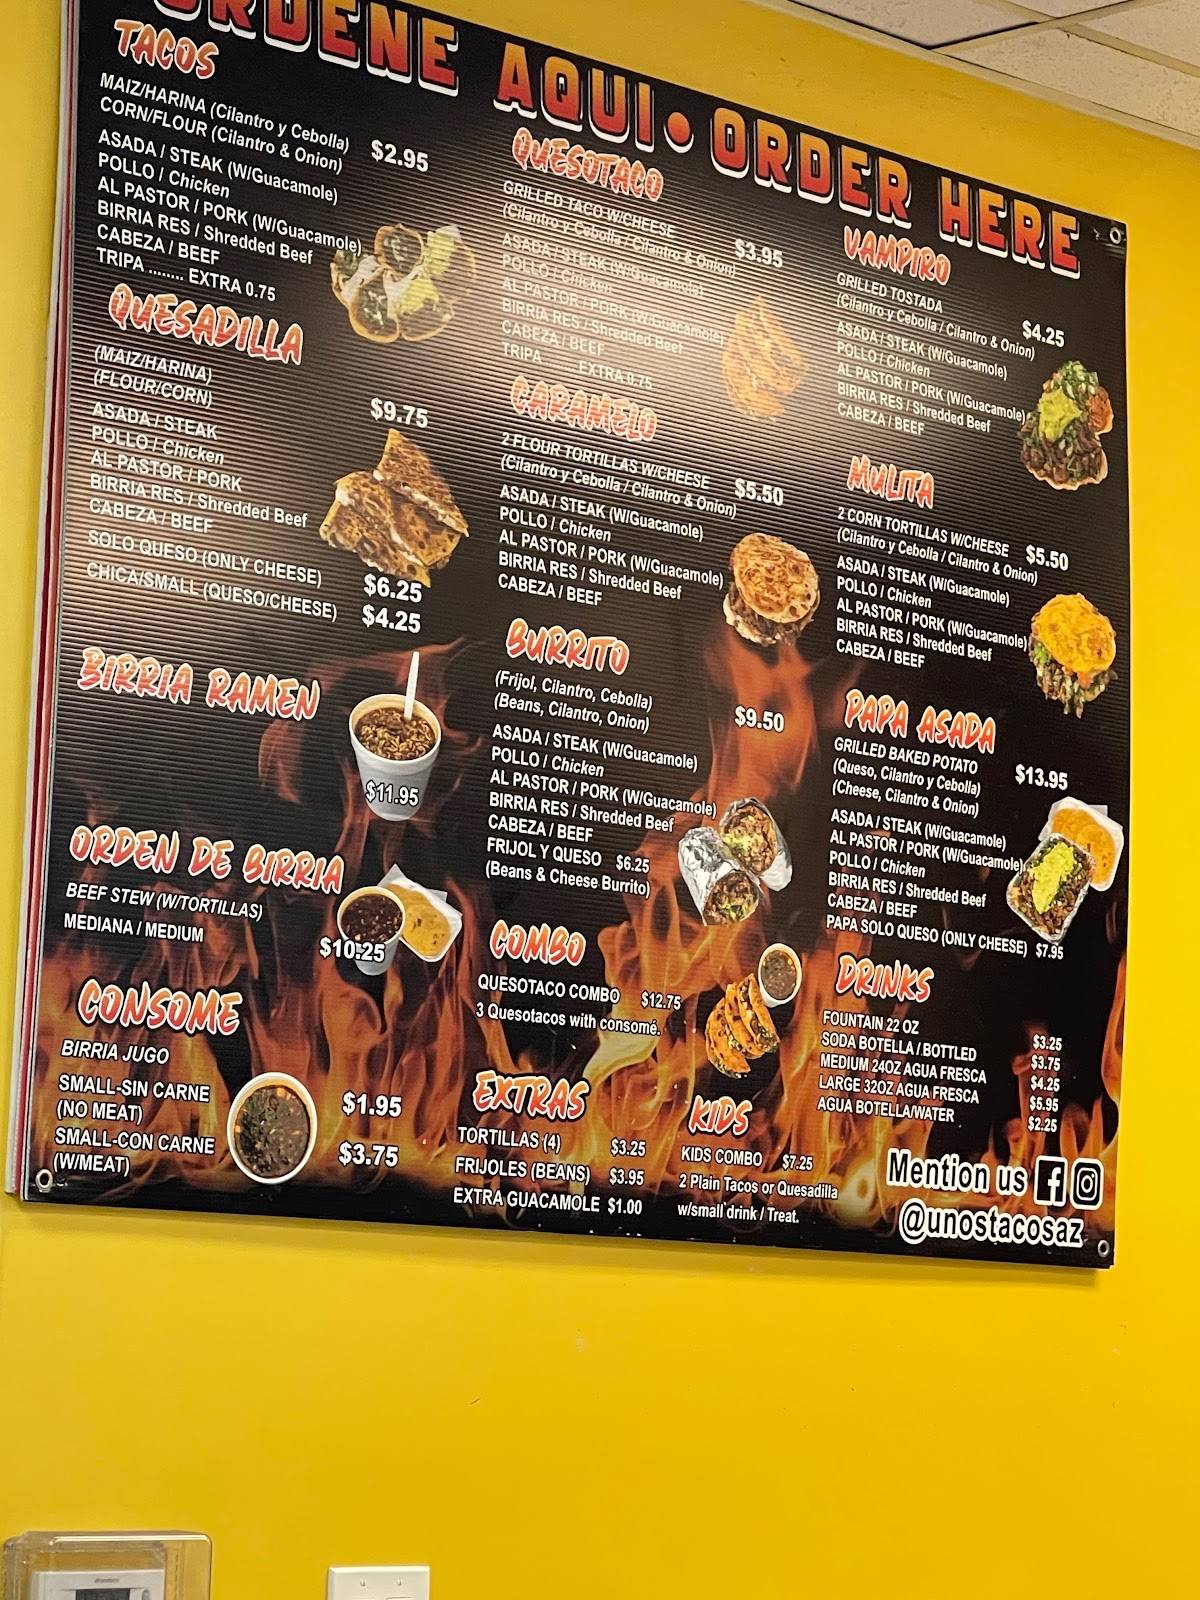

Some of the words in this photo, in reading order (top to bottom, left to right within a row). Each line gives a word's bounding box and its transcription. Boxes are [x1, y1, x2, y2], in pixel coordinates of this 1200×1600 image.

[114, 20, 219, 79] TACOS
[100, 72, 206, 114] MAIZ/HARINA
[211, 103, 274, 132] (Cilantro
[278, 123, 287, 137] y
[291, 124, 349, 154] Cebolla)
[100, 97, 208, 138] CORN/FLOUR
[212, 125, 276, 153] (Cilantro
[280, 143, 290, 157] &
[295, 146, 343, 175] Onion)
[371, 139, 429, 172] $2.95
[493, 41, 654, 151] AQUI
[708, 107, 912, 230] ORDER
[938, 174, 1081, 279] HERE
[512, 127, 664, 202] QUESOTACO
[735, 238, 784, 268] $3.95
[844, 224, 950, 286] VAMPIRO
[837, 273, 887, 297] GRILLED
[891, 287, 943, 313] TOSTADA
[108, 283, 303, 365] QUESADILLA
[1022, 320, 1065, 348] $4.25
[94, 345, 212, 385] (MAIZ/HARINA)
[370, 398, 429, 428] $9.75
[510, 375, 657, 442] CARAMELO
[501, 432, 510, 444] 2
[512, 434, 560, 456] FLOUR
[564, 446, 638, 473] TORTILLAS
[642, 463, 710, 489] W/CHEESE
[734, 478, 784, 506] $5.50
[847, 454, 934, 510] MULITA
[838, 507, 845, 520] 2
[848, 509, 882, 530] CORN
[885, 517, 947, 543] TORTILLAS
[951, 532, 1009, 557] W/CHEESE
[88, 530, 135, 552] SOLO
[139, 537, 198, 562] QUESO
[202, 549, 249, 573] (ONLY
[254, 558, 322, 588] CHEESE)
[1026, 545, 1069, 571] $5.50
[86, 562, 198, 596] CHICA/SMALL
[203, 581, 337, 622] (QUESO/CHEESE)
[364, 573, 422, 602] $6.25
[362, 604, 421, 633] $4.25
[506, 617, 629, 675] BURRITO
[78, 647, 193, 704] BIRRIA
[206, 668, 322, 721] RAMEN
[495, 669, 537, 692] (Frijol,
[542, 678, 596, 702] Cilantro,
[601, 688, 652, 712] Cebolla)
[494, 692, 544, 716] (Beans,
[548, 702, 602, 726] Cilantro,
[607, 711, 650, 734] Onion)
[734, 706, 784, 732] $9.50
[844, 688, 908, 739] PAPA
[917, 706, 997, 754] ASADA
[835, 737, 886, 759] GRILLED
[889, 747, 930, 767] BAKED
[933, 754, 978, 775] POTATO
[366, 781, 419, 806] $11.95
[833, 758, 877, 779] (Queso,
[880, 766, 924, 787] Cilantro
[927, 775, 934, 790] y
[937, 775, 981, 797] Cebolla)
[1015, 764, 1068, 790] $13.95
[832, 779, 881, 801] (Cheese,
[885, 788, 929, 808] Cilantro
[932, 796, 940, 809] &
[943, 797, 979, 818] Onion)
[69, 825, 180, 875] ORDEN
[188, 837, 235, 879] DE
[243, 845, 346, 894] BIRRIA
[487, 837, 536, 860] FRIJOL
[540, 843, 548, 858] Y
[553, 846, 602, 867] QUESO
[615, 855, 650, 873] $6.25
[485, 860, 532, 881] (Beans
[536, 866, 546, 882] &
[550, 868, 598, 888] Cheese
[602, 875, 650, 898] Burrito)
[66, 883, 107, 902] BEEF
[111, 888, 155, 907] STEW
[157, 893, 263, 921] (W/TORTILLAS)
[320, 937, 385, 962] $10.25
[489, 919, 586, 967] COMBO
[826, 914, 858, 932] PAPA
[861, 920, 894, 937] SOLO
[897, 924, 939, 941] QUESO
[942, 929, 976, 949] (ONLY
[978, 935, 1027, 957] CHEESE)
[1036, 943, 1063, 960] $7.95
[478, 973, 565, 998] QUESOTACO
[569, 983, 620, 1004] COMBO
[641, 991, 681, 1010] $12.75
[836, 954, 934, 1003] DRINKS
[77, 978, 243, 1035] CONSOME
[476, 1002, 484, 1017] 3
[488, 1004, 566, 1027] Quesotacos
[570, 1011, 596, 1029] with
[599, 1015, 660, 1036] consomé.
[823, 1010, 883, 1030] FOUNTAIN
[886, 1019, 900, 1032] 22
[903, 1020, 919, 1035] OZ
[61, 1039, 120, 1060] BIRRIA
[122, 1046, 170, 1064] JUGO
[1033, 1034, 1062, 1051] $3.25
[820, 1054, 869, 1071] MEDIUM
[903, 1063, 938, 1079] AGUA
[940, 1066, 986, 1084] FRESCA
[1031, 1055, 1061, 1071] $3.75
[58, 1075, 149, 1097] SMALL-SIN
[153, 1082, 210, 1102] CARNE
[473, 1069, 592, 1121] EXTRAS
[819, 1075, 861, 1093] LARGE
[896, 1083, 930, 1099] AGUA
[933, 1087, 979, 1104] FRESCA
[1030, 1075, 1060, 1092] $4.25
[56, 1102, 88, 1120] (NO
[92, 1105, 143, 1124] MEAT)
[342, 1091, 402, 1118] $1.95
[688, 1094, 753, 1137] KIDS
[817, 1096, 853, 1113] AGUA
[856, 1100, 954, 1123] BOTELLA/WATER
[55, 1127, 154, 1150] SMALL-CON
[158, 1134, 215, 1155] CARNE
[458, 1126, 539, 1149] TORTILLAS
[544, 1132, 561, 1153] (4)
[610, 1138, 646, 1157] $3.25
[1028, 1116, 1058, 1133] $2.25
[53, 1153, 130, 1176] (W/MEAT)
[338, 1142, 399, 1167] $3.75
[455, 1157, 527, 1178] FRIJOLES
[531, 1161, 590, 1185] (BEANS)
[609, 1167, 644, 1186] $3.95
[681, 1145, 713, 1163] KIDS
[715, 1149, 762, 1167] COMBO
[782, 1153, 813, 1171] $7.25
[887, 1148, 991, 1193] Mention
[996, 1164, 1028, 1197] us
[453, 1187, 502, 1206] EXTRA
[507, 1191, 599, 1213] GUACAMOLE
[607, 1197, 642, 1216] $1.00
[679, 1174, 687, 1189] 2
[690, 1175, 720, 1191] Plain
[723, 1177, 759, 1193] Tacos
[762, 1181, 774, 1194] or
[777, 1181, 838, 1199] Quesadilla
[899, 1198, 1085, 1248] @unostacosaz
